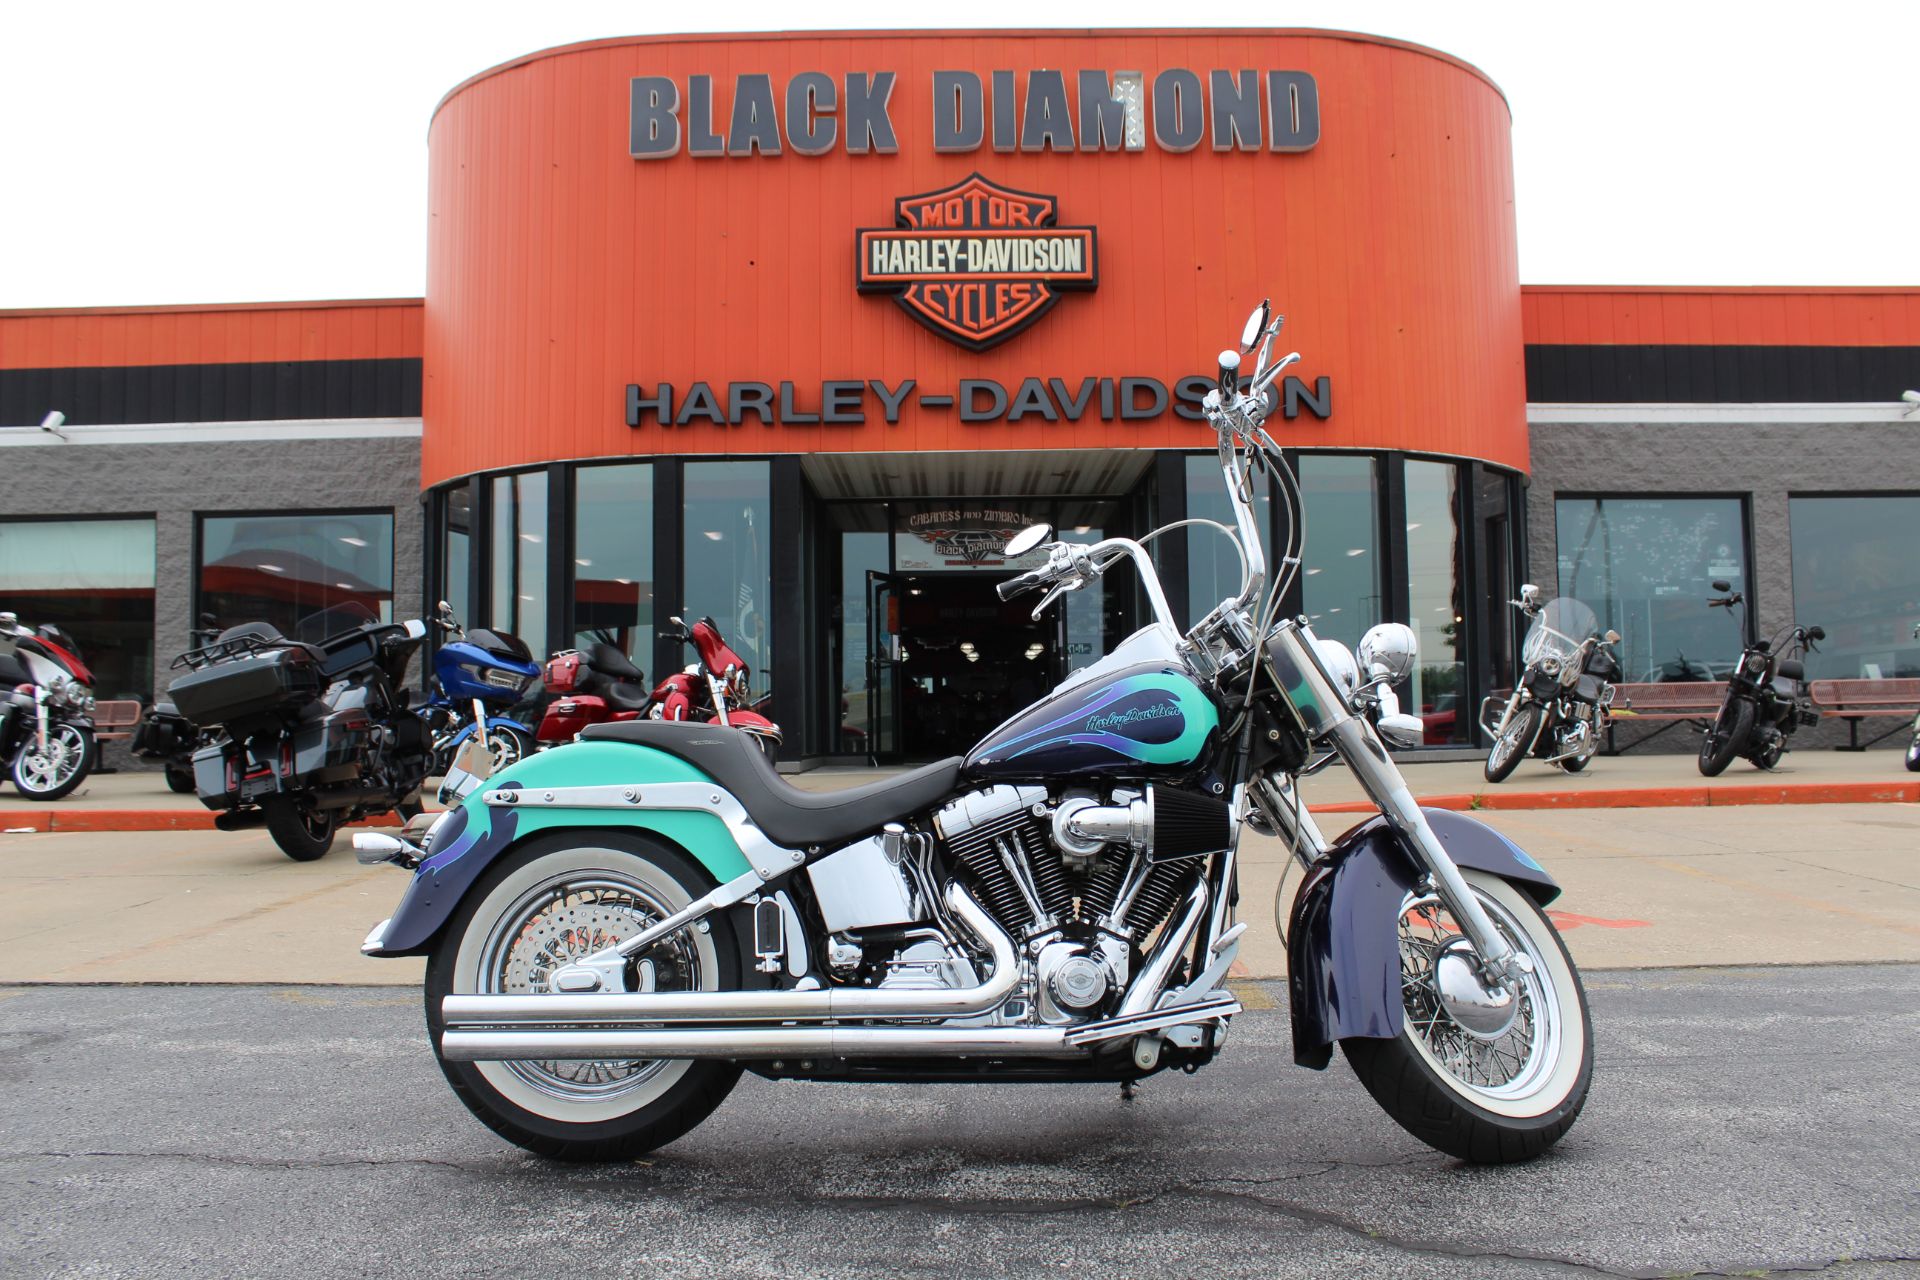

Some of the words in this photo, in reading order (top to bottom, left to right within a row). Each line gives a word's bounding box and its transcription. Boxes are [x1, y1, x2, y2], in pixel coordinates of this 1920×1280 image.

[629, 72, 899, 159] BLACK
[932, 68, 1320, 152] DIAMOND
[921, 187, 1032, 227] MOTOR
[872, 238, 1082, 274] HARLEY-DAVIDSON
[923, 283, 1032, 330] CYCLES
[910, 509, 961, 526] CABANESS
[984, 509, 1020, 525] ZIMBRO
[935, 543, 966, 555] Black
[967, 540, 1008, 553] Diamon
